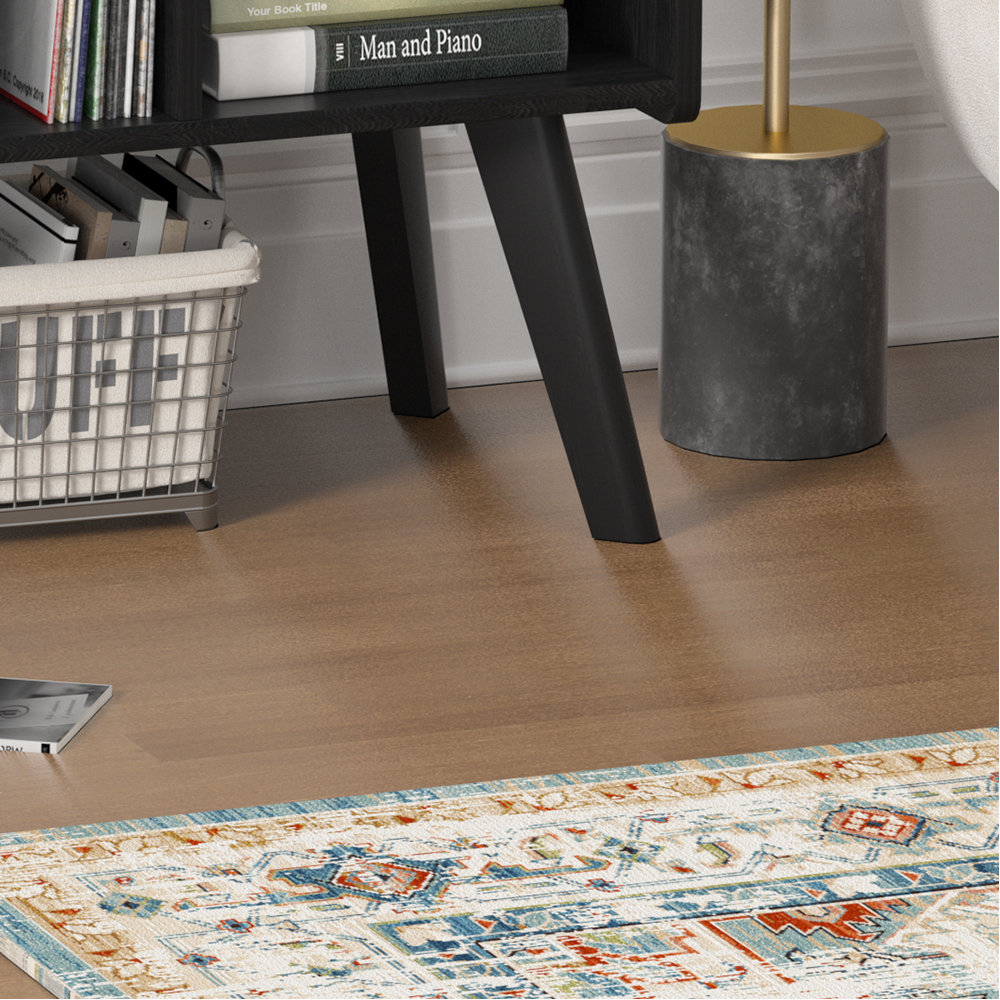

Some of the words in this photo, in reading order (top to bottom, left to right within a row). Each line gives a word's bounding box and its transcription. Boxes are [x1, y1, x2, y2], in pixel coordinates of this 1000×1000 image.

[247, 6, 271, 17] Your
[273, 4, 302, 16] Book
[305, 1, 328, 13] Title
[335, 42, 345, 61] VIII
[359, 34, 397, 61] Man
[401, 28, 432, 57] and
[435, 28, 483, 55] Piano
